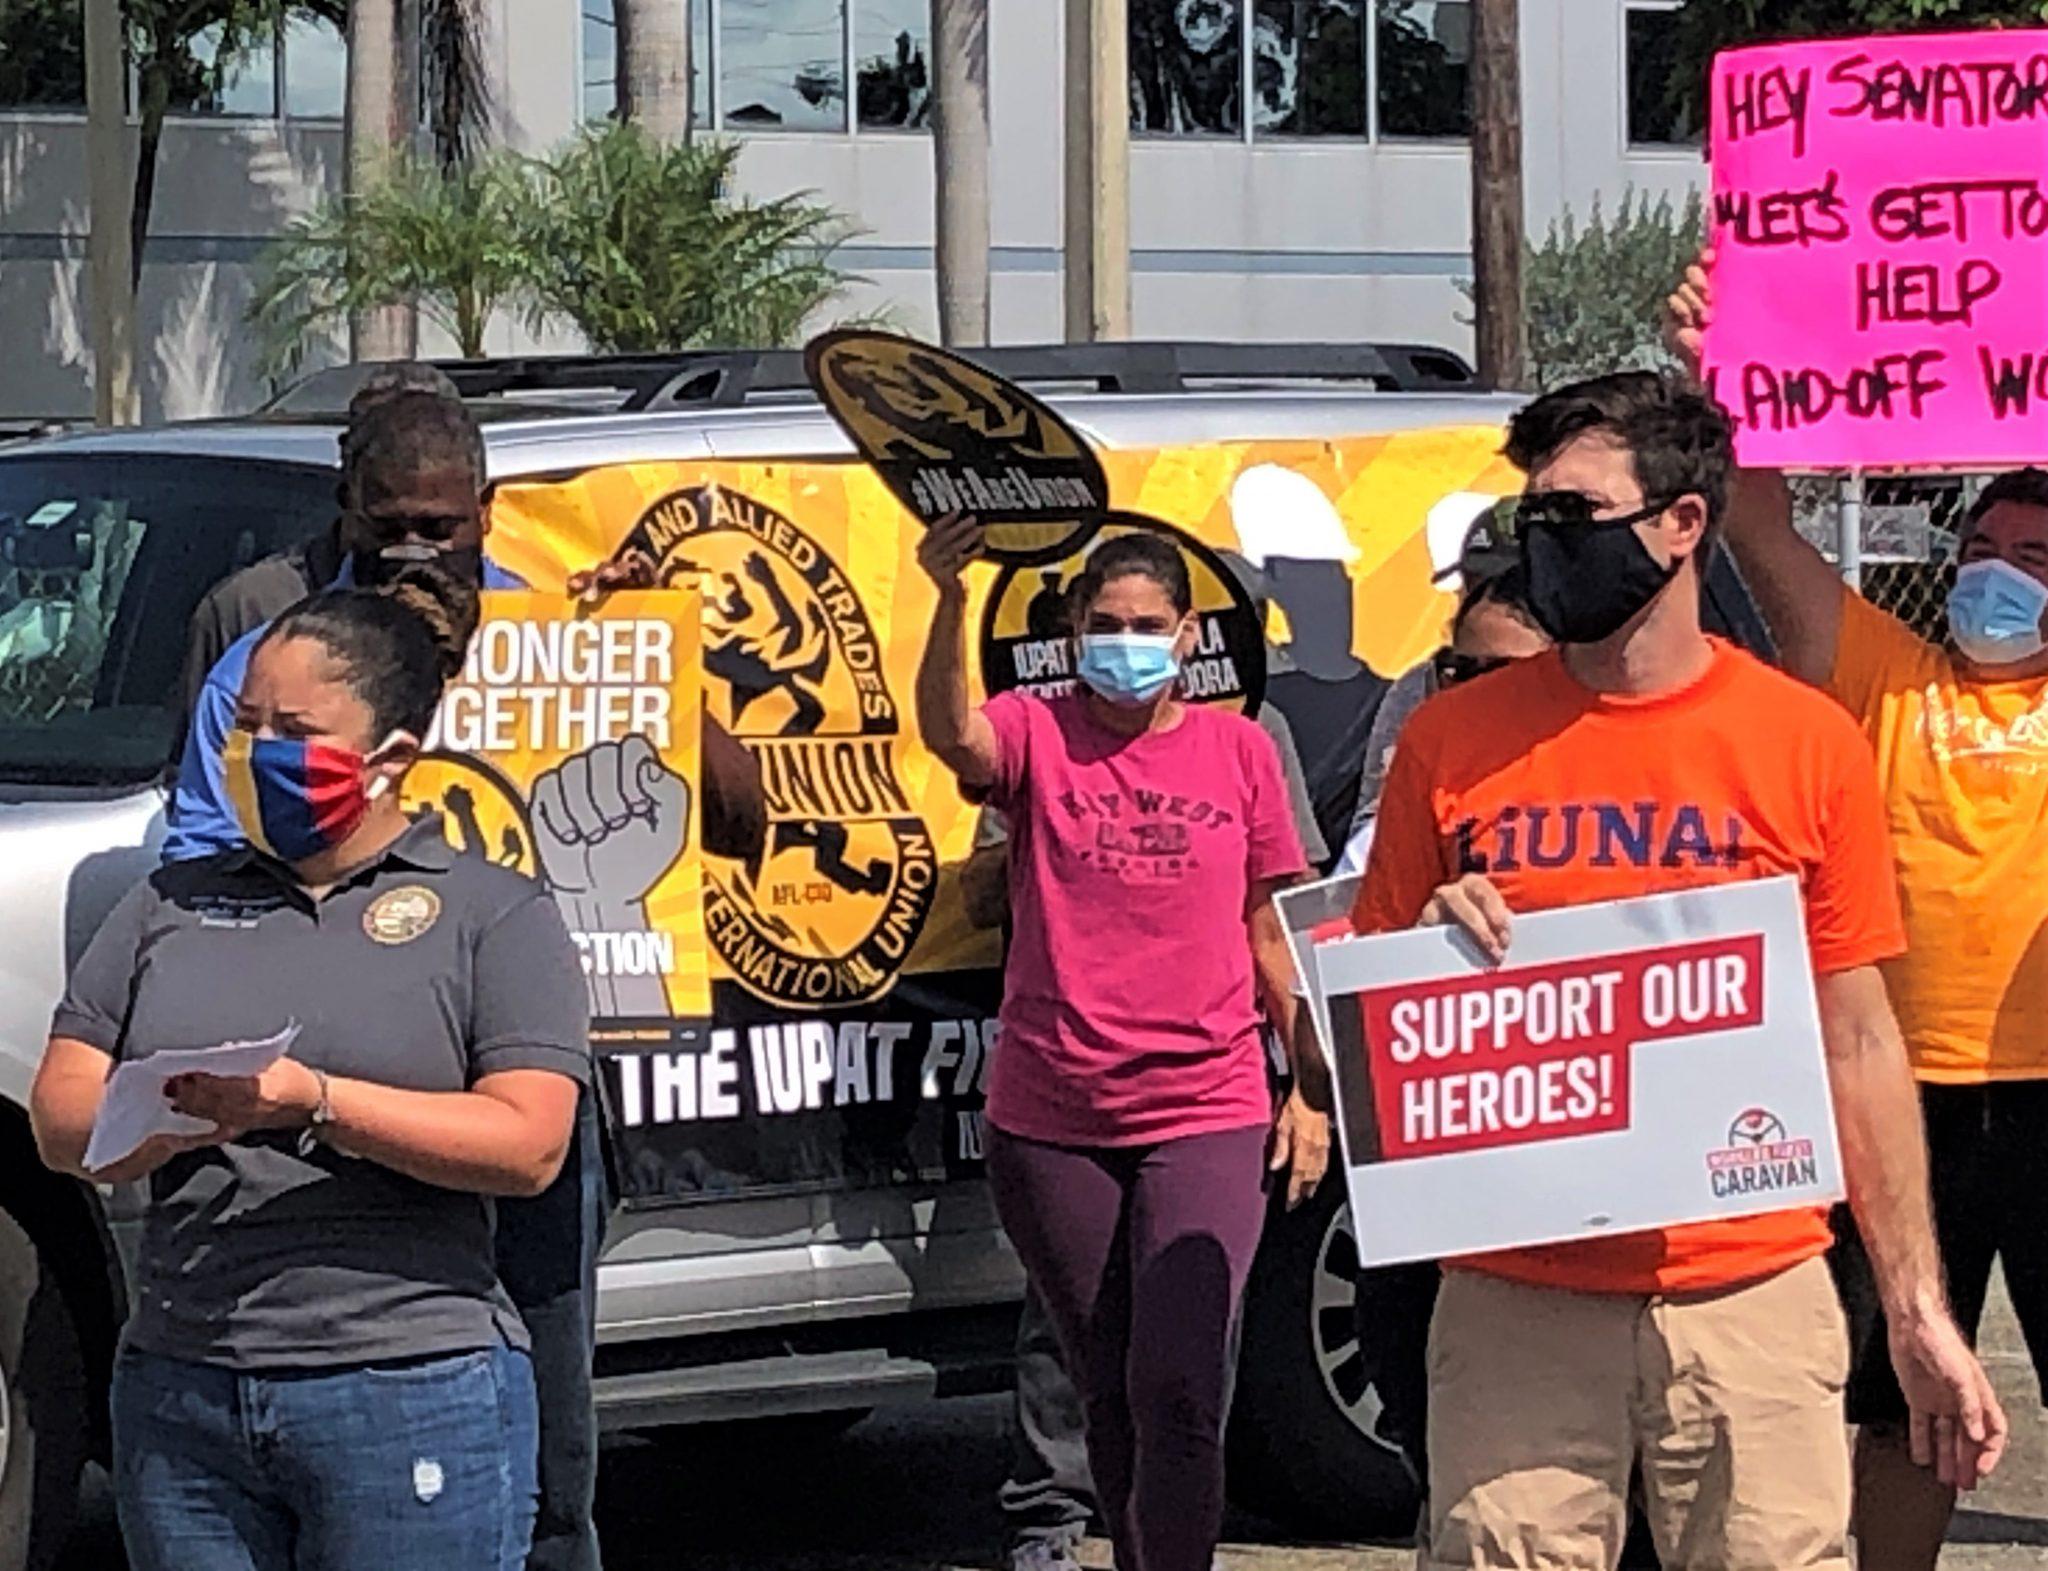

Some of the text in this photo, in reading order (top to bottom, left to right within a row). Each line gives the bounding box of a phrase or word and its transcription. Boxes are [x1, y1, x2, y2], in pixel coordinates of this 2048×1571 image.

[1725, 65, 1810, 158] HEY
[1869, 178, 1984, 243] GET
[1988, 178, 2048, 241] TO
[1856, 259, 2002, 332] HELP
[644, 489, 892, 719] AND ALLIED TRADES
[1012, 637, 1070, 680] IUPAT
[762, 741, 912, 815] UNION
[874, 833, 933, 959] UNION
[1390, 954, 1749, 1063] SUPPORT OUR
[610, 1029, 740, 1126] THE
[748, 1020, 913, 1115] IUPAT
[1401, 1055, 1615, 1143] HEROES!
[1711, 1158, 1818, 1198] CARAVAN
